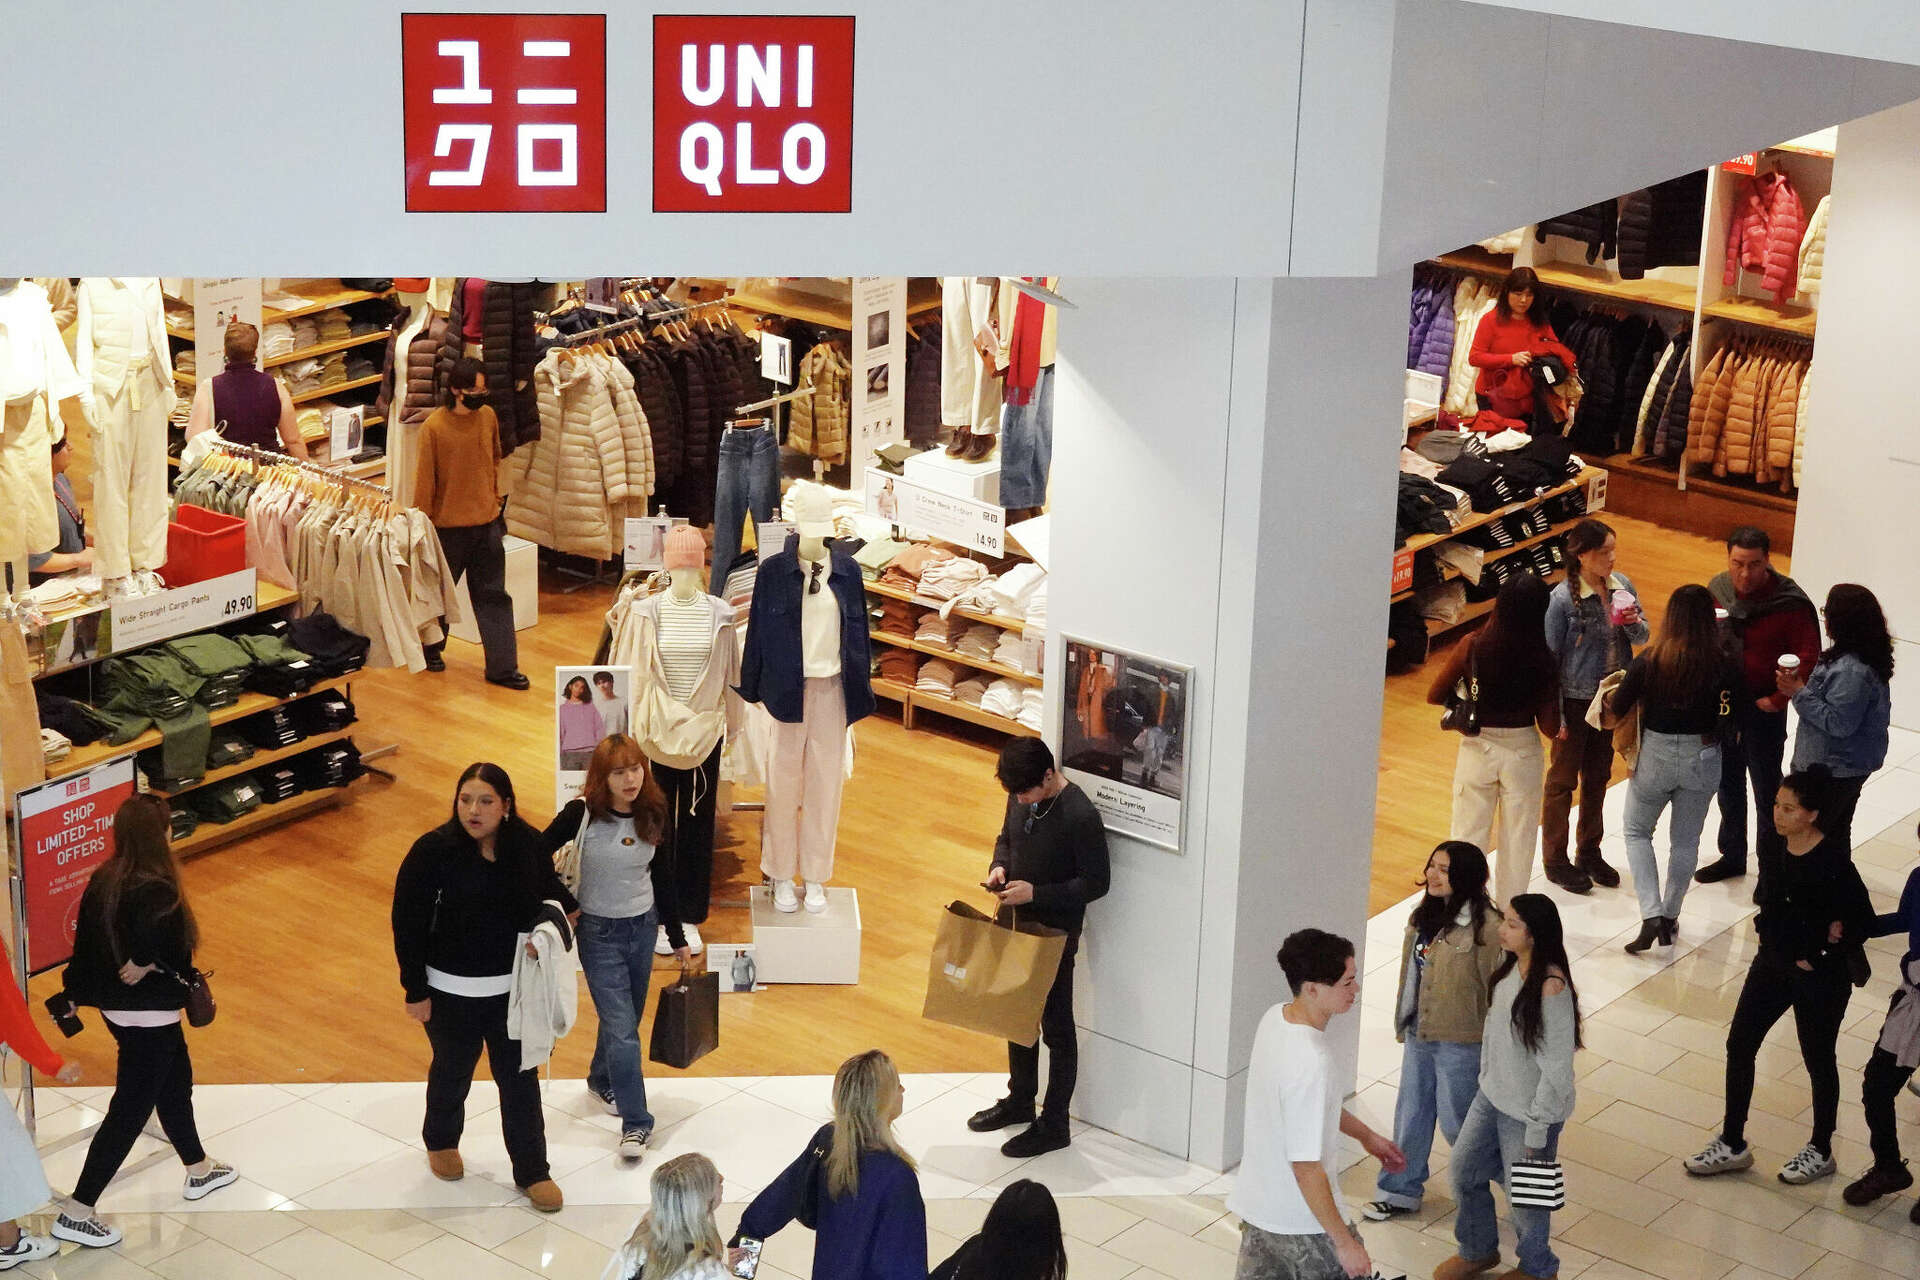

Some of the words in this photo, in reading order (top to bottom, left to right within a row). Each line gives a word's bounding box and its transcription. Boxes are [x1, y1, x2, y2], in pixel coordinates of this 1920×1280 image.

[432, 40, 577, 104] ユニ
[681, 44, 814, 108] UNI
[428, 124, 578, 186] クロ
[679, 121, 826, 196] QLO
[119, 614, 137, 625] Wide
[139, 605, 166, 620] Straight
[168, 599, 189, 611] Cargo
[191, 593, 210, 606] Pants
[63, 801, 96, 827] SHOP
[1096, 790, 1118, 802] Modern
[1119, 797, 1146, 813] Layering
[37, 814, 115, 855] LIMITED-TIM
[57, 836, 105, 866] OFFERS
